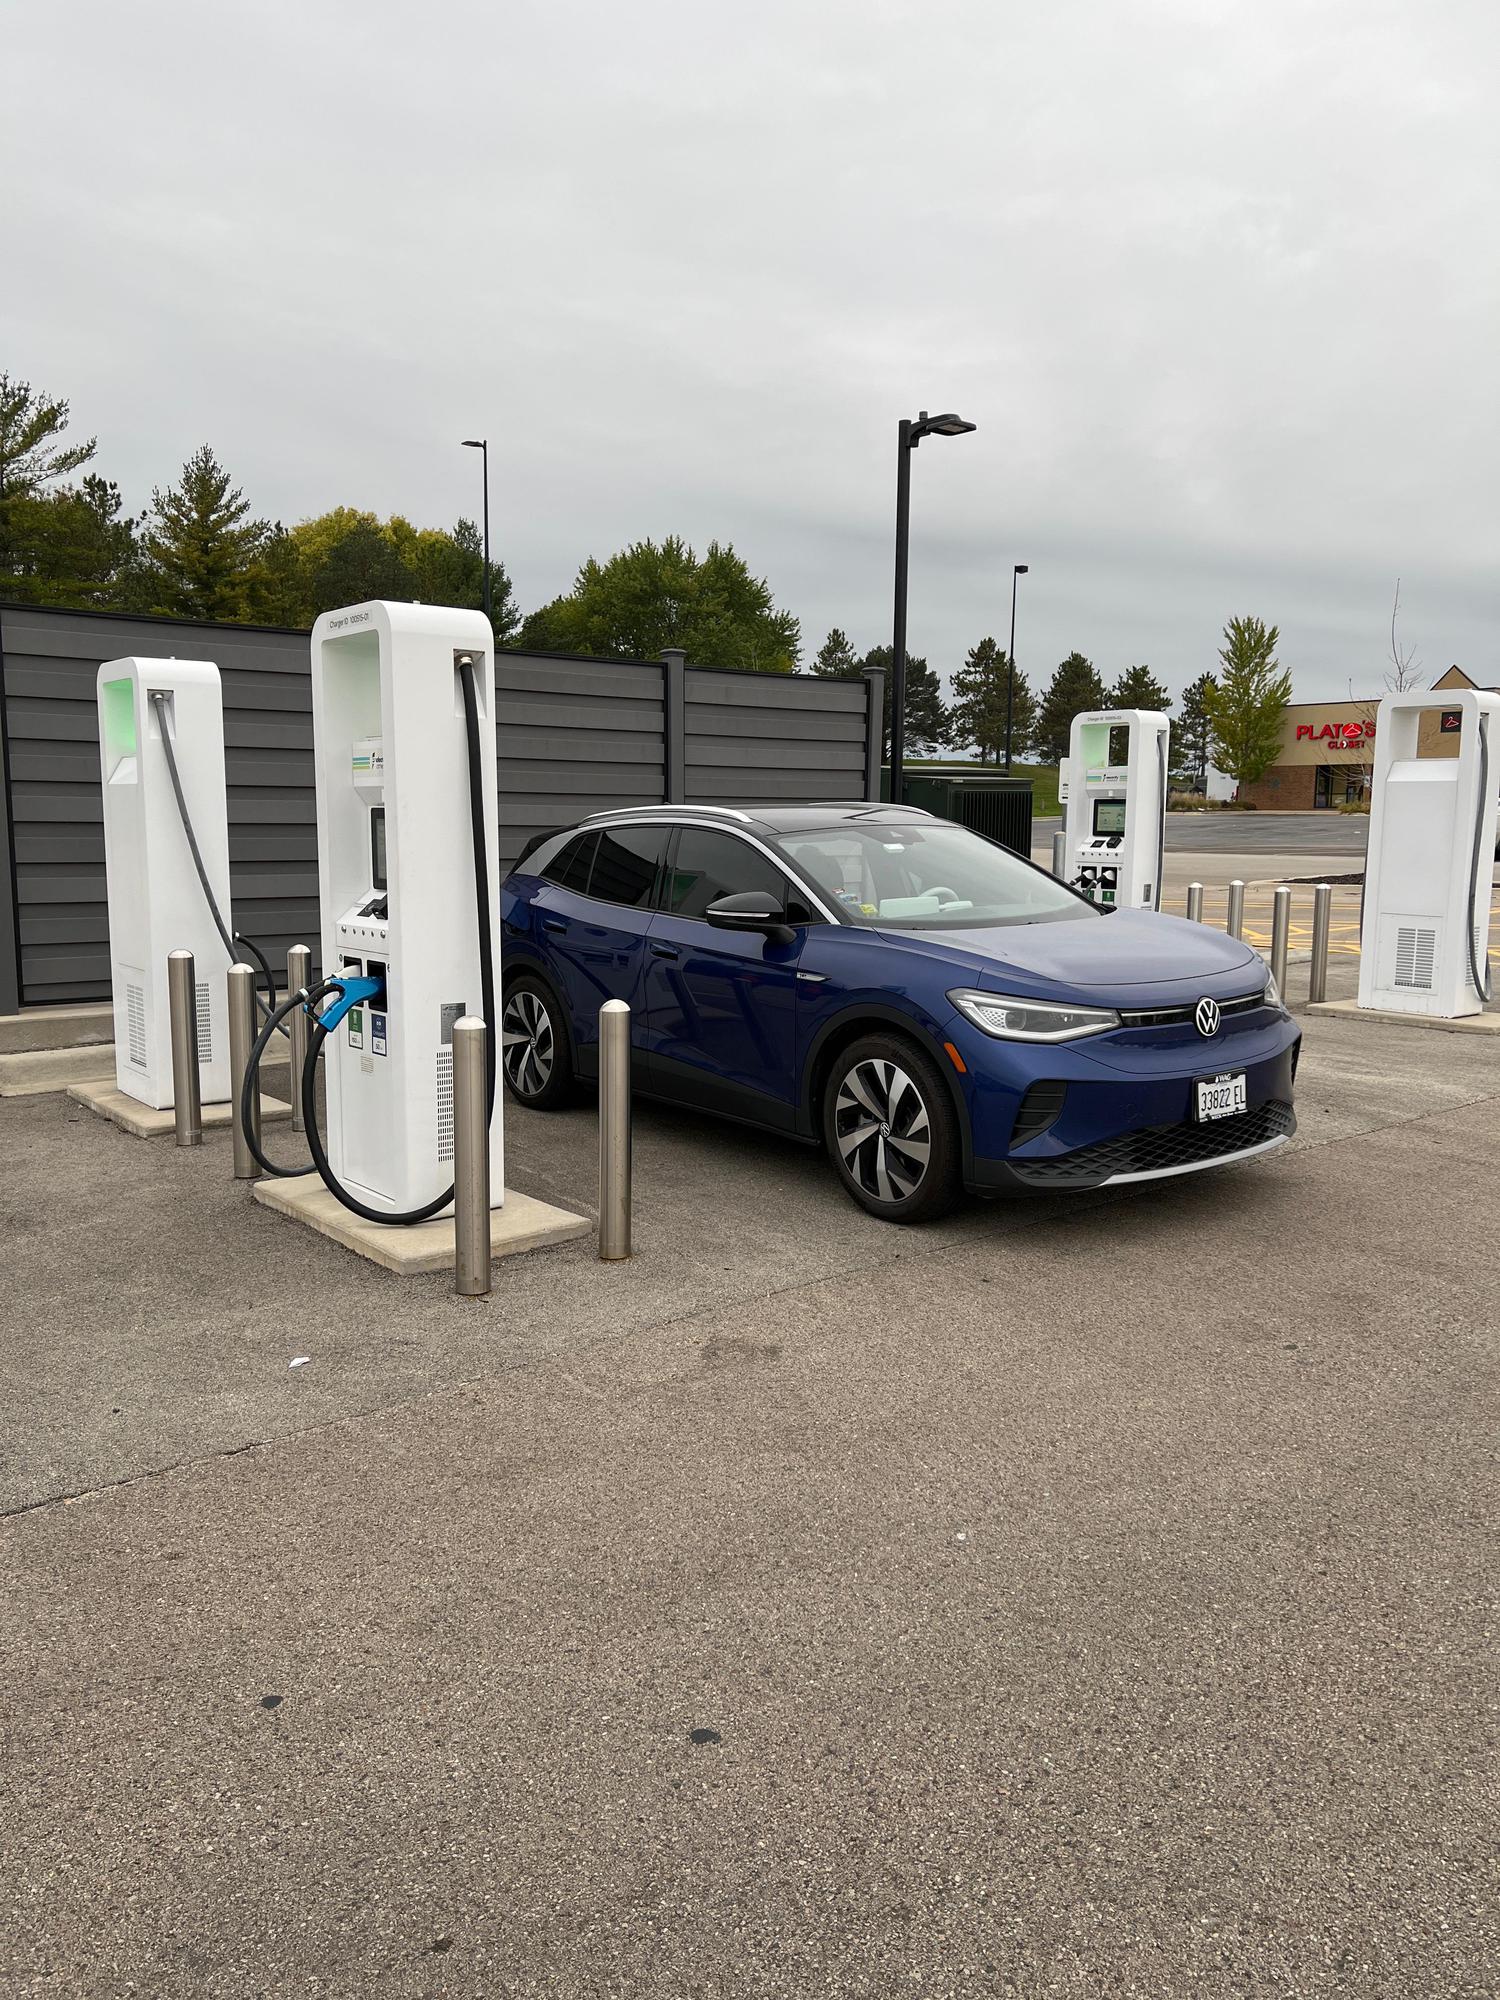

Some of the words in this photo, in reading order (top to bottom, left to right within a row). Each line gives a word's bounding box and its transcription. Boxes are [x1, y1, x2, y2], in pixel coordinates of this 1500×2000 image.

[1296, 720, 1376, 741] PLATO'S
[1328, 740, 1365, 750] CLOSET
[1201, 1087, 1231, 1112] 33822
[1234, 1084, 1246, 1105] EL
